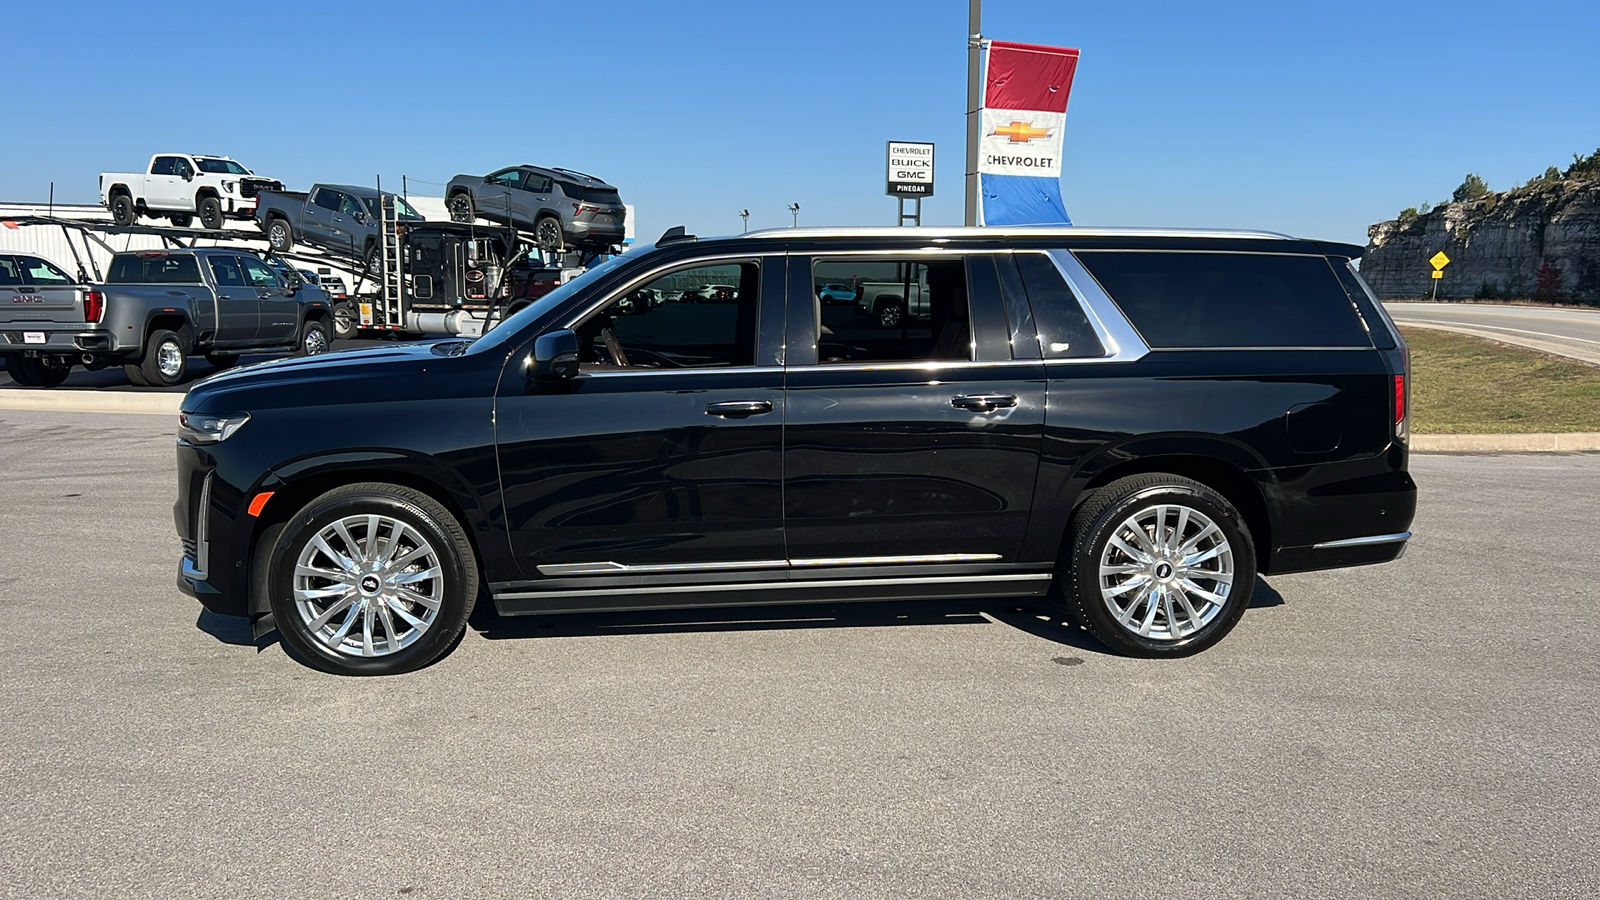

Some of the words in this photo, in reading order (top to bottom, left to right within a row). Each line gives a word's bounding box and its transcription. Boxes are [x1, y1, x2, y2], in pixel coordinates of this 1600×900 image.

[892, 147, 931, 155] CHEVROLET
[891, 159, 931, 167] BUICK
[987, 154, 1054, 168] CHEVROLET
[897, 171, 926, 179] GMC
[896, 184, 926, 193] PINEGAR
